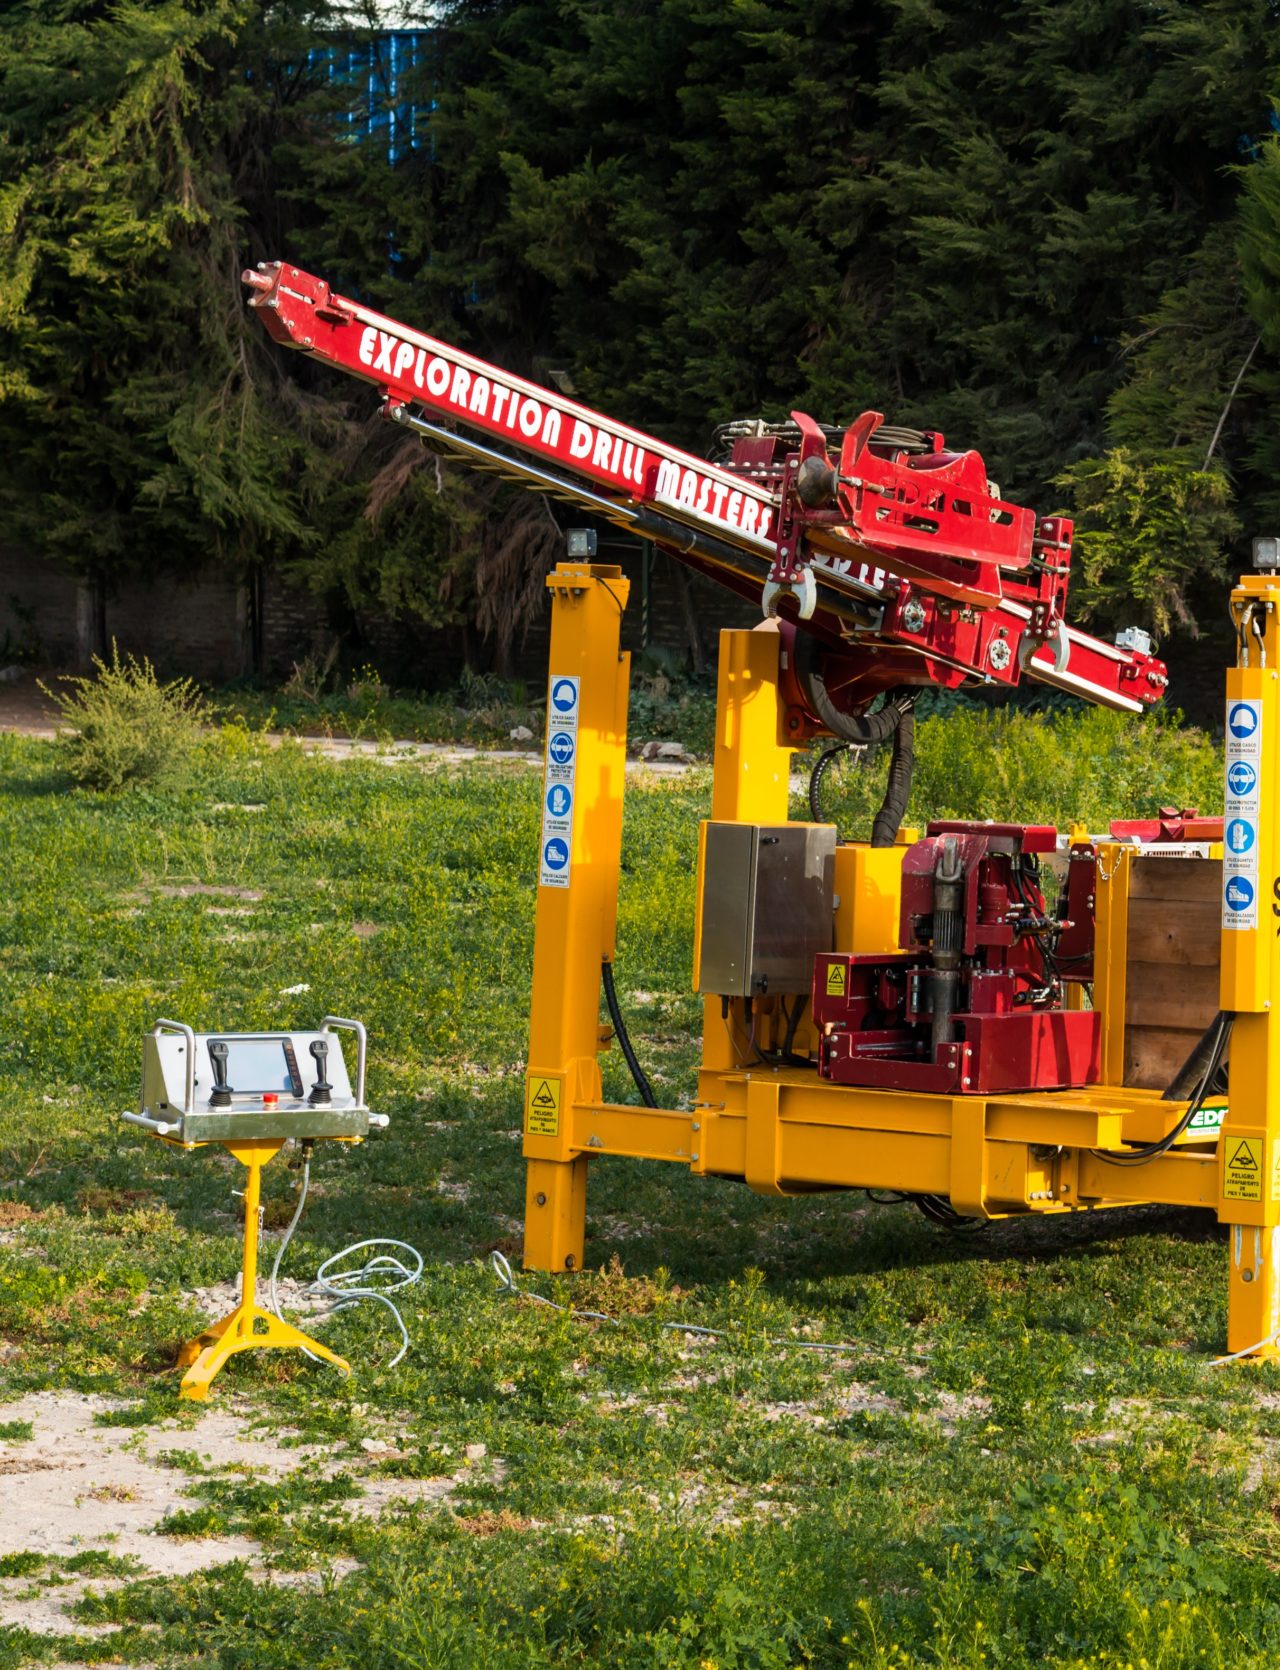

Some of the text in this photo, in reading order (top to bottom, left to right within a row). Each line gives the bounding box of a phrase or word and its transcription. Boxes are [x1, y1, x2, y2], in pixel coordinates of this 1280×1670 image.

[359, 326, 773, 538] EXPLORATION DRILL MASTERS
